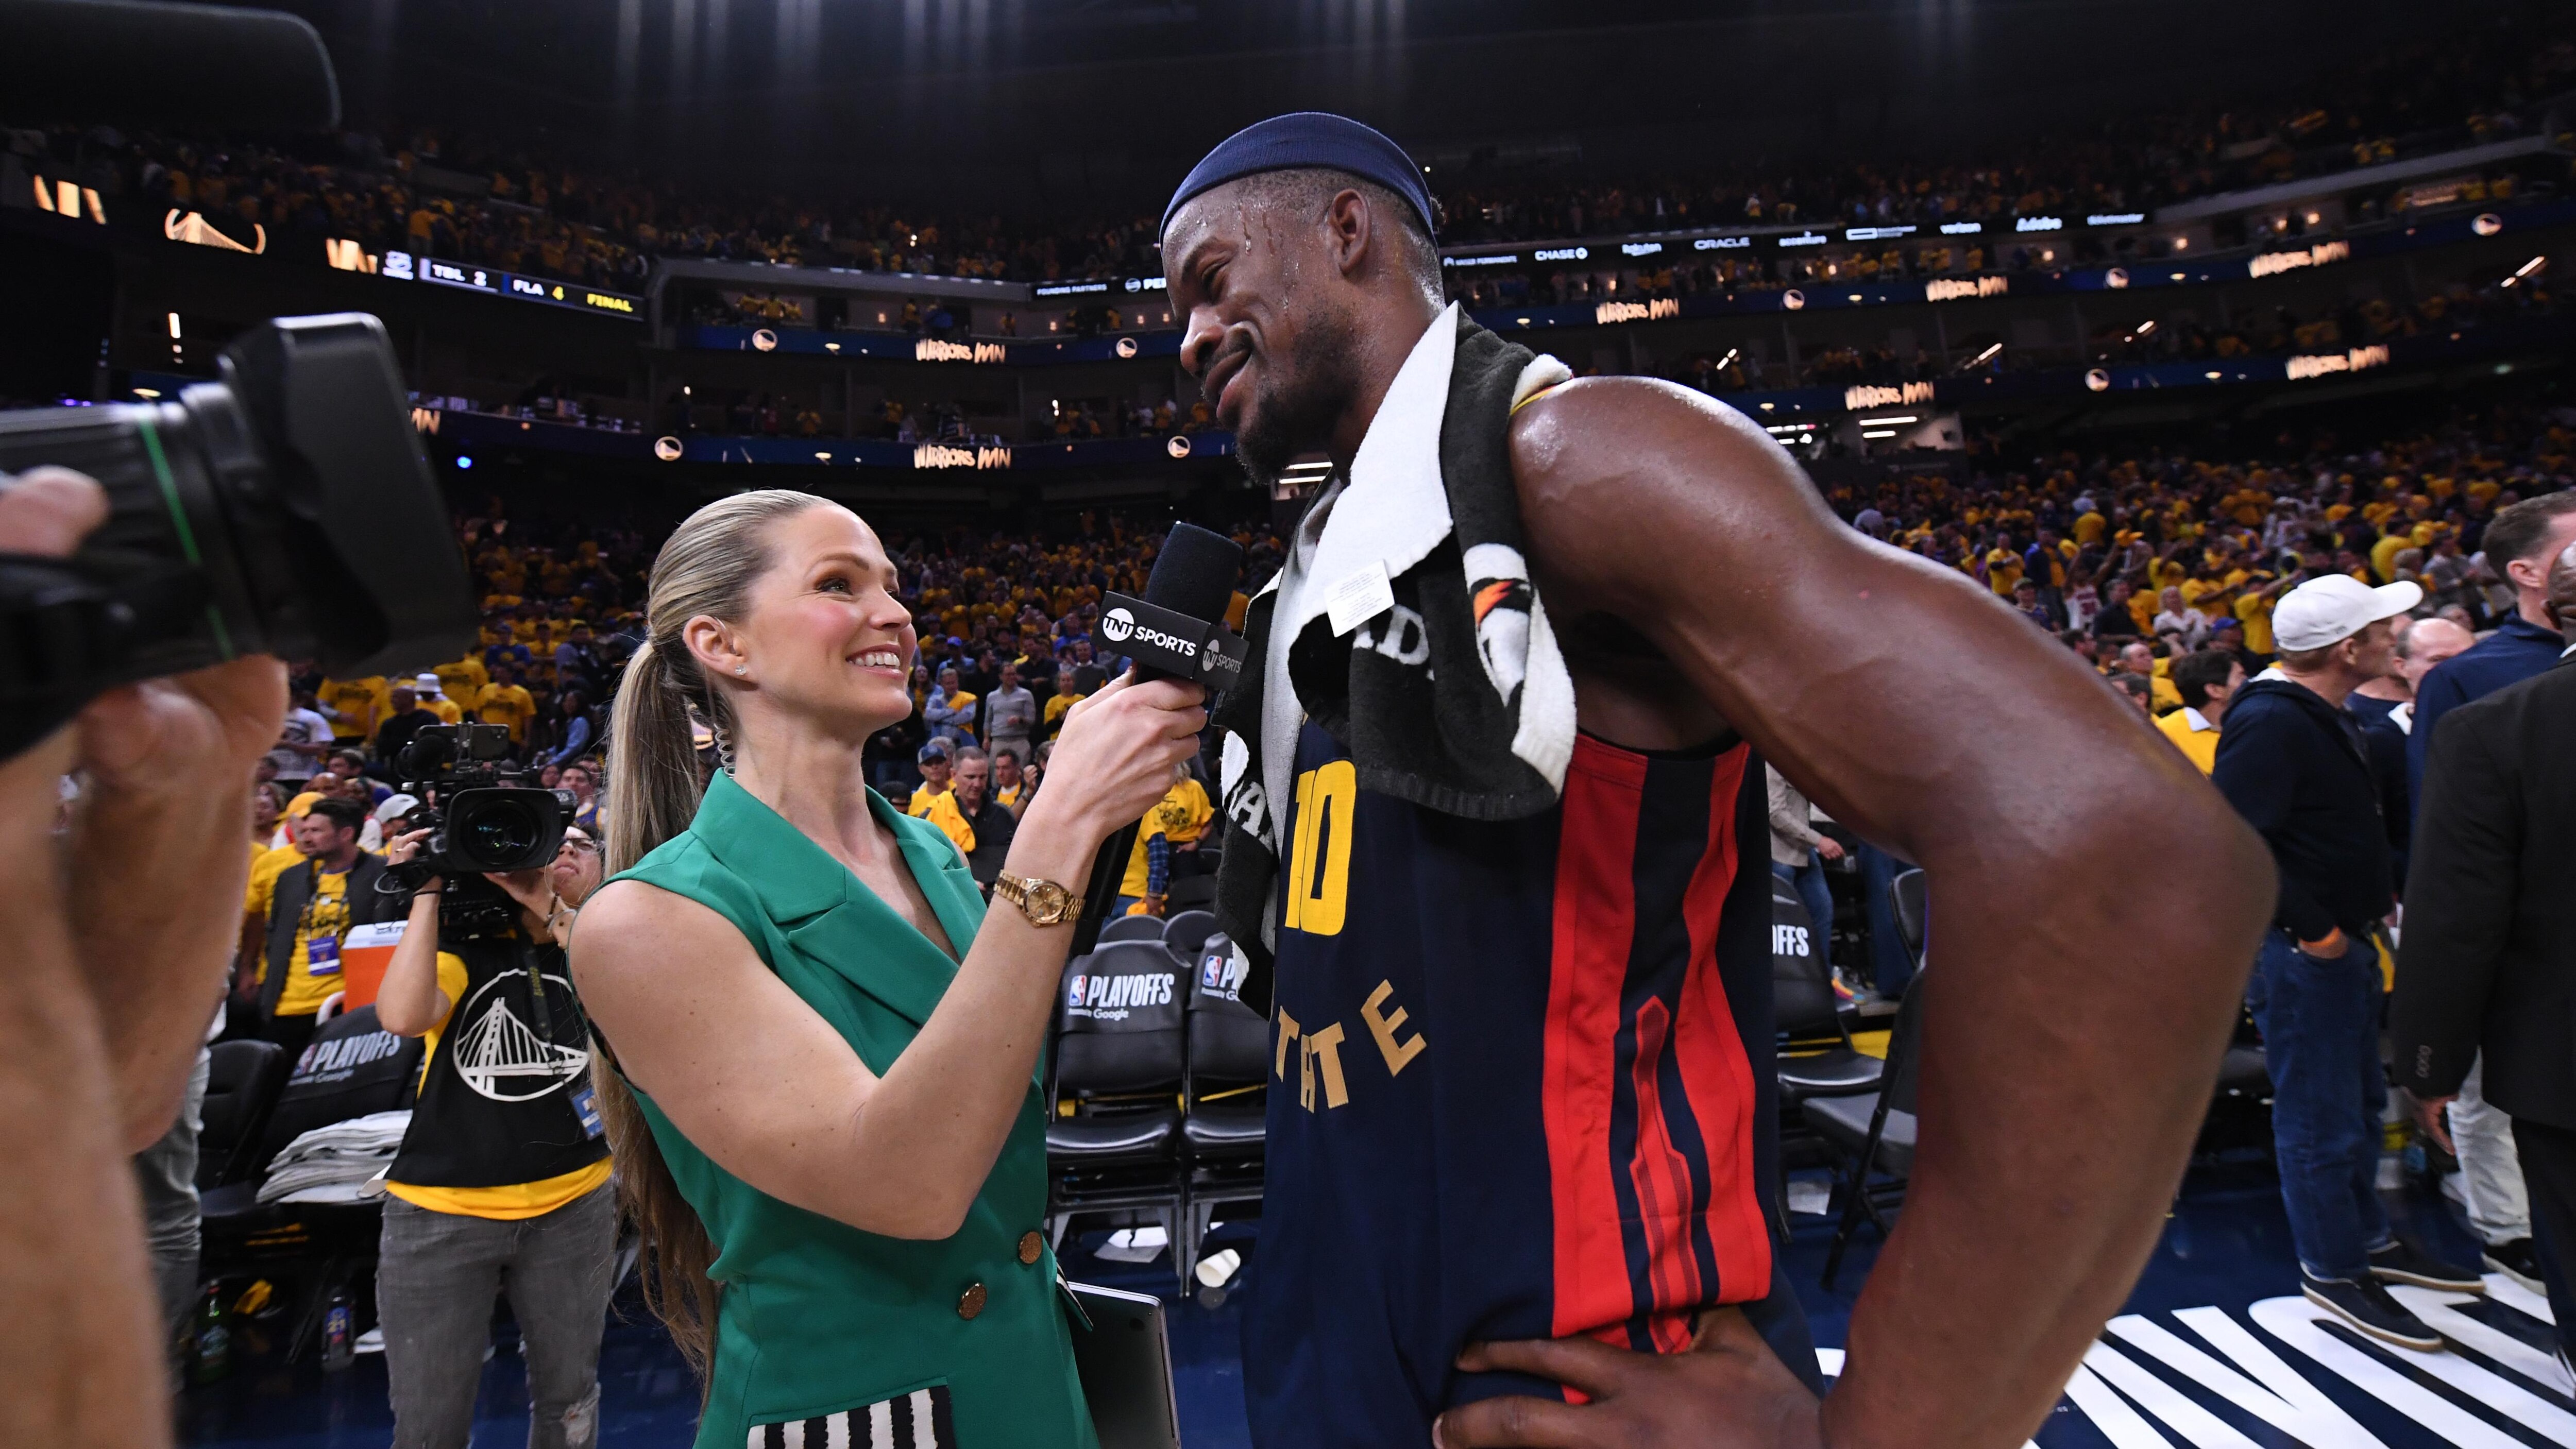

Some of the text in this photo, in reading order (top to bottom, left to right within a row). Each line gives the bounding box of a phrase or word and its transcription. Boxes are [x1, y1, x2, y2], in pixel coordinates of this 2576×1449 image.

[1535, 249, 1575, 261] CHASE
[1694, 237, 1750, 250] ORACLE
[473, 270, 487, 287] 2
[513, 279, 544, 296] FLA
[552, 286, 565, 301] 4
[586, 293, 633, 312] FINAL
[916, 338, 973, 362] WARRIORS
[914, 444, 975, 469] WARRIORS
[1134, 626, 1197, 657] SPORTS
[1216, 655, 1242, 674] SPORTS
[1285, 759, 1357, 936] 10
[1086, 973, 1175, 1008] PLAYOFFS
[1093, 1008, 1129, 1021] Google
[309, 1030, 401, 1073] PLAYOFFS
